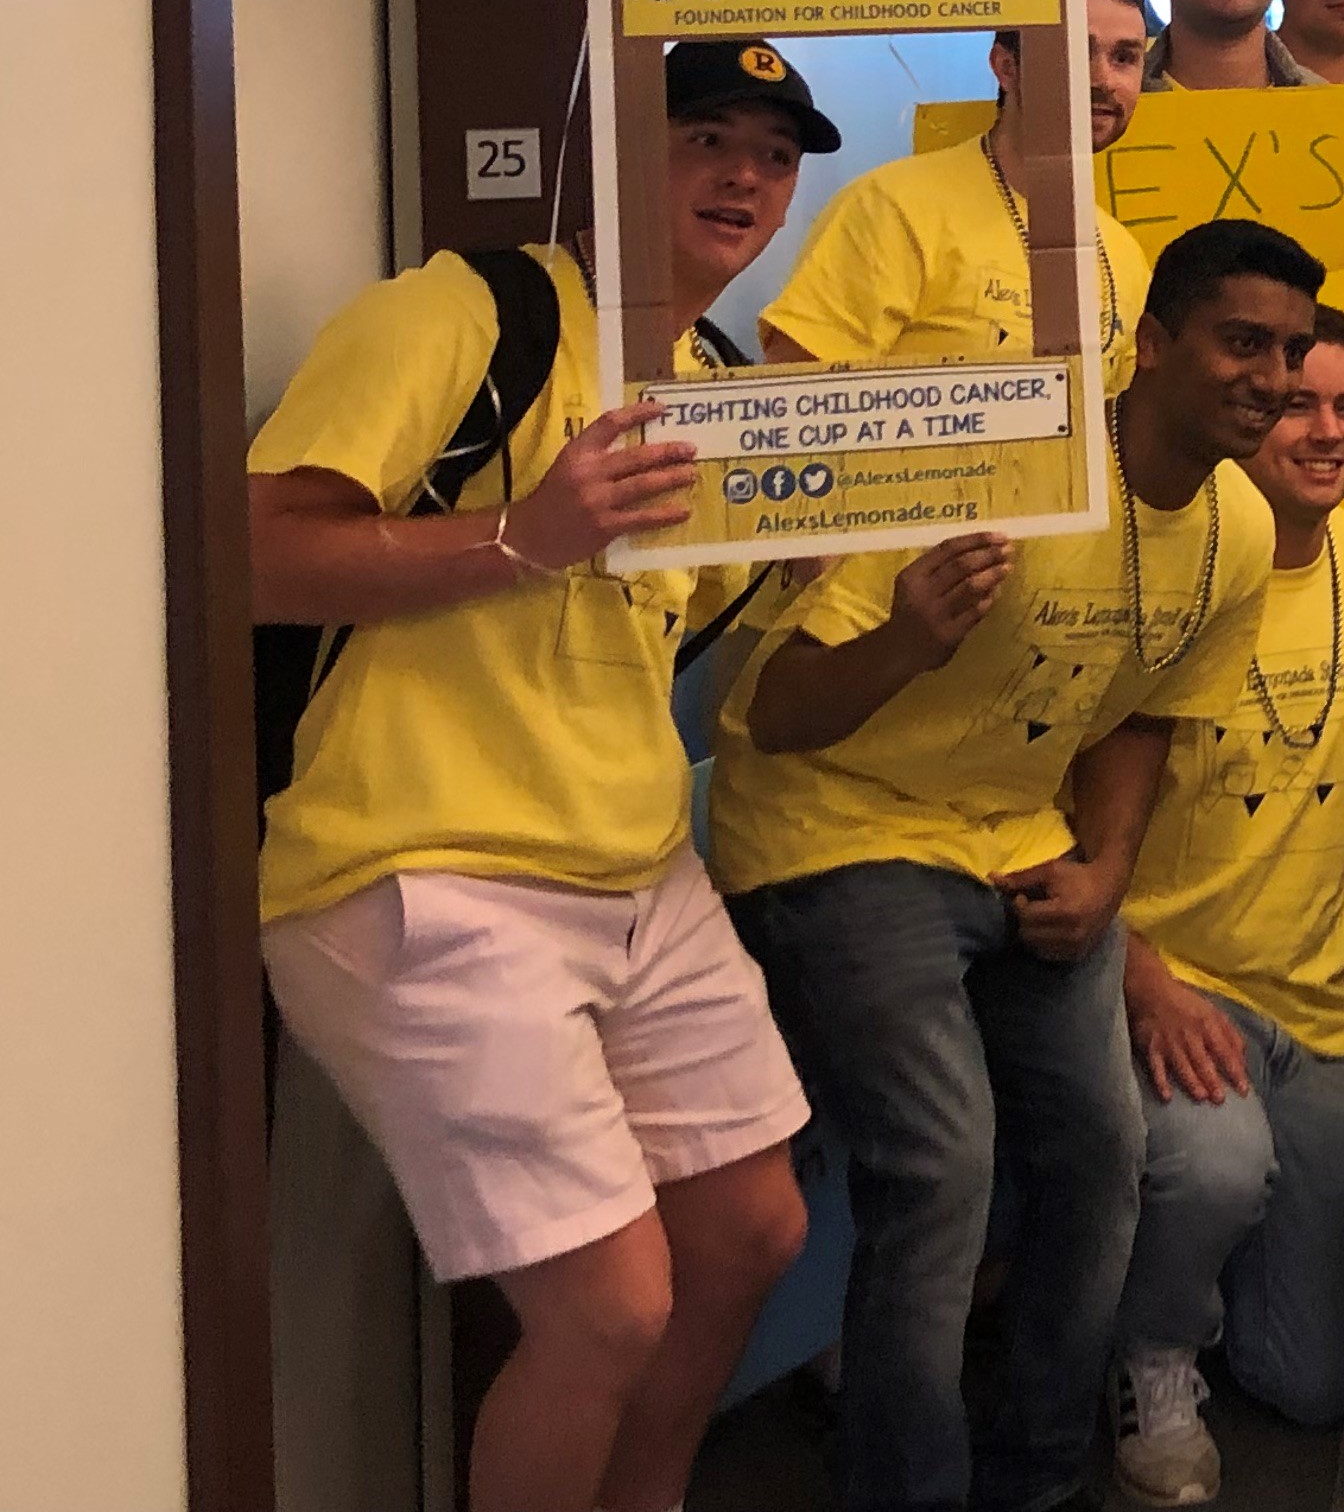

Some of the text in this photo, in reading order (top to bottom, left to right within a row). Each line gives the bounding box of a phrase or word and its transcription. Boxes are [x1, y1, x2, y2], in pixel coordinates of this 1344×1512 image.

[673, 0, 1003, 27] FOUNDATION FOR CHILDHOOD CANCER
[477, 140, 526, 178] 25
[660, 396, 788, 428] FIGHTING
[795, 386, 942, 418] CHILDHOOD
[738, 412, 987, 452] ONE CUP AT A TIME
[837, 460, 997, 489] @AlexsLemonade
[755, 498, 979, 534] AlexsLemonade.org
